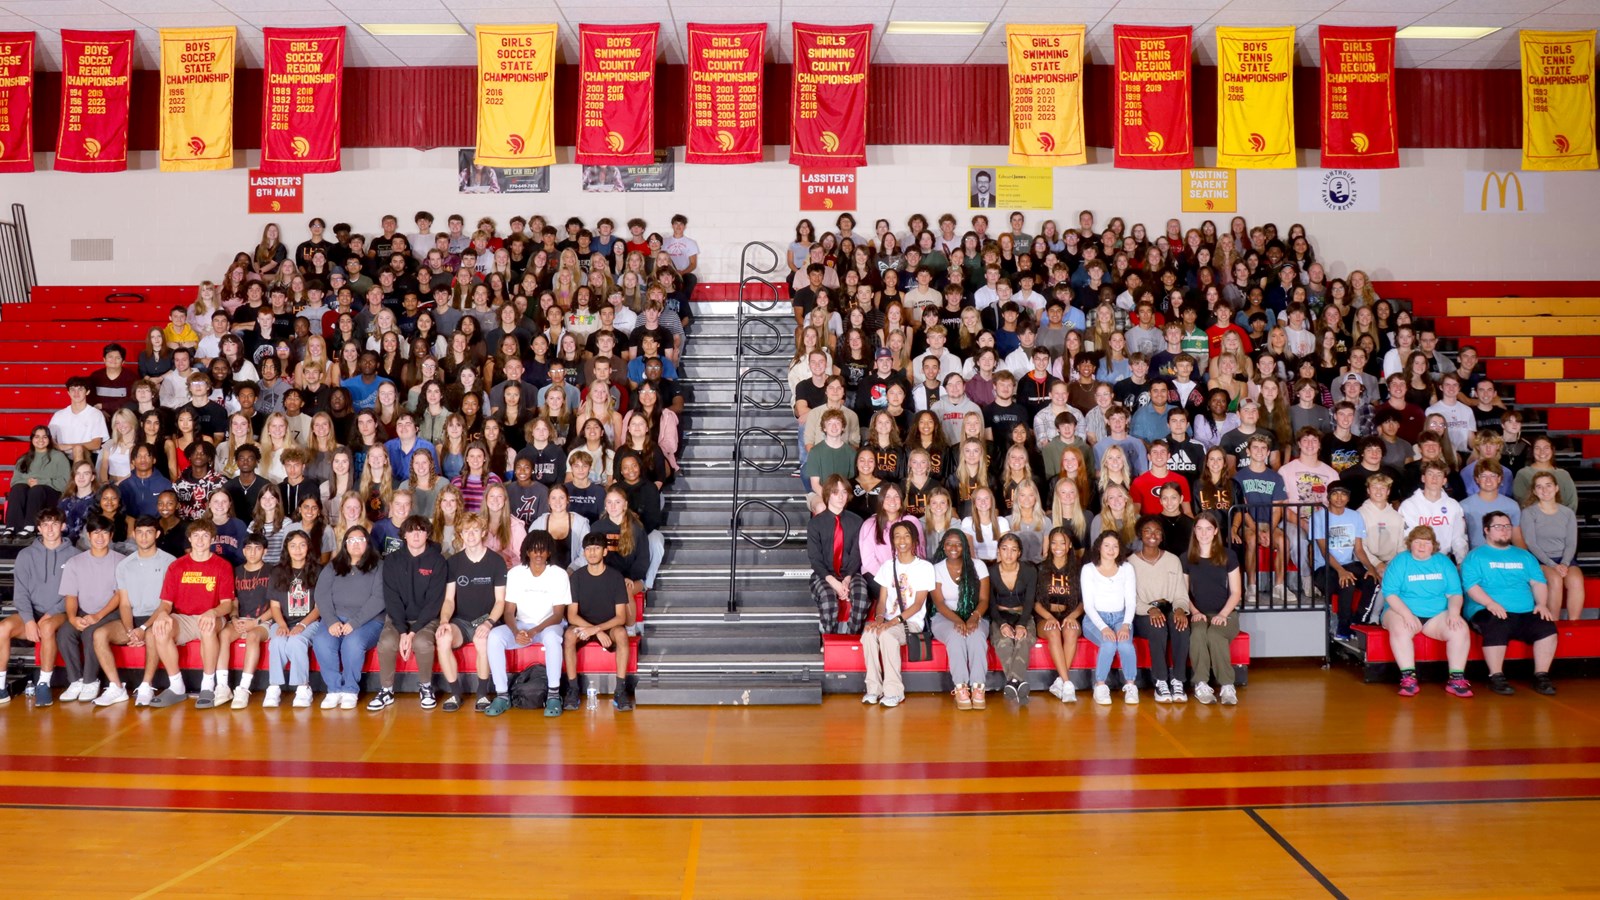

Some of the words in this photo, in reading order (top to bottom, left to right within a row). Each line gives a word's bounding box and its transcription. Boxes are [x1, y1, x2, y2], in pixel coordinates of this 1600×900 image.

[501, 38, 532, 46] GIRLS
[607, 38, 631, 47] BOYS
[712, 38, 741, 47] GIRLS
[817, 36, 846, 45] GIRLS
[1032, 38, 1060, 47] GIRLS
[85, 46, 109, 54] BOYS
[186, 43, 210, 51] BOYS
[291, 42, 318, 51] GIRLS
[1140, 41, 1165, 50] BOYS
[1243, 43, 1268, 51] BOYS
[1343, 42, 1372, 51] GIRLS
[1543, 45, 1572, 54] GIRLS
[0, 46, 11, 55] LS
[497, 49, 536, 58] SOCCER
[595, 48, 641, 58] SWIMMING
[702, 49, 749, 58] SWIMMING
[808, 48, 855, 58] SWIMMING
[1023, 50, 1069, 59] SWIMMING
[79, 56, 113, 64] SOCCER
[181, 53, 215, 62] SOCCER
[286, 52, 323, 62] SOCCER
[1135, 51, 1170, 60] TENNIS
[1237, 53, 1272, 62] TENNIS
[1340, 52, 1374, 62] TENNIS
[0, 56, 21, 65] OSSE
[1540, 56, 1575, 65] TENNIS
[185, 63, 211, 73] STATE
[287, 64, 320, 73] REGION
[501, 61, 532, 70] STATE
[600, 61, 635, 70] COUNTY
[708, 61, 744, 70] COUNTY
[812, 62, 850, 71] COUNTY
[1031, 62, 1060, 71] STATE
[1136, 61, 1171, 70] REGION
[1240, 63, 1270, 72] STATE
[1341, 63, 1376, 72] REGION
[0, 67, 9, 76] EA
[79, 66, 111, 75] REGION
[1543, 66, 1572, 75] STATE
[167, 73, 229, 84] CHAMPIONSHIP
[271, 74, 335, 84] CHAMPIONSHIP
[483, 72, 548, 82] CHAMPIONSHIP
[584, 72, 650, 82] CHAMPIONSHIP
[693, 71, 758, 82] CHAMPIONSHIP
[798, 73, 865, 84] CHAMPIONSHIP
[1014, 73, 1078, 83] CHAMPIONSHIP
[1121, 71, 1185, 81] CHAMPIONSHIP
[1224, 73, 1288, 82] CHAMPIONSHIP
[1328, 73, 1388, 83] CHAMPIONSHIP
[1529, 74, 1589, 85] CHAMPIONSHIP
[0, 76, 29, 87] ONSHIP
[68, 77, 128, 86] CHAMPIONSHIP
[272, 87, 291, 95] 1989
[695, 84, 711, 92] 1993
[739, 94, 756, 102] 2007
[696, 110, 712, 118] 1998
[740, 111, 756, 119] 2010
[740, 119, 755, 128] 2011
[802, 174, 854, 183] LASSITER'S
[1190, 171, 1228, 179] VISITING
[1322, 170, 1356, 185] LIGHTHOUSE
[251, 176, 301, 186] LASSITER'S
[1190, 180, 1227, 188] PARENT
[275, 188, 296, 197] MAN
[828, 185, 849, 194] MAN
[1190, 190, 1229, 198] SEATING
[1322, 190, 1336, 210] FAMILY
[1338, 190, 1357, 211] RETREAT
[1243, 480, 1276, 495] IRISH
[1419, 516, 1449, 525] NASA
[181, 576, 216, 584] BASKETBALL
